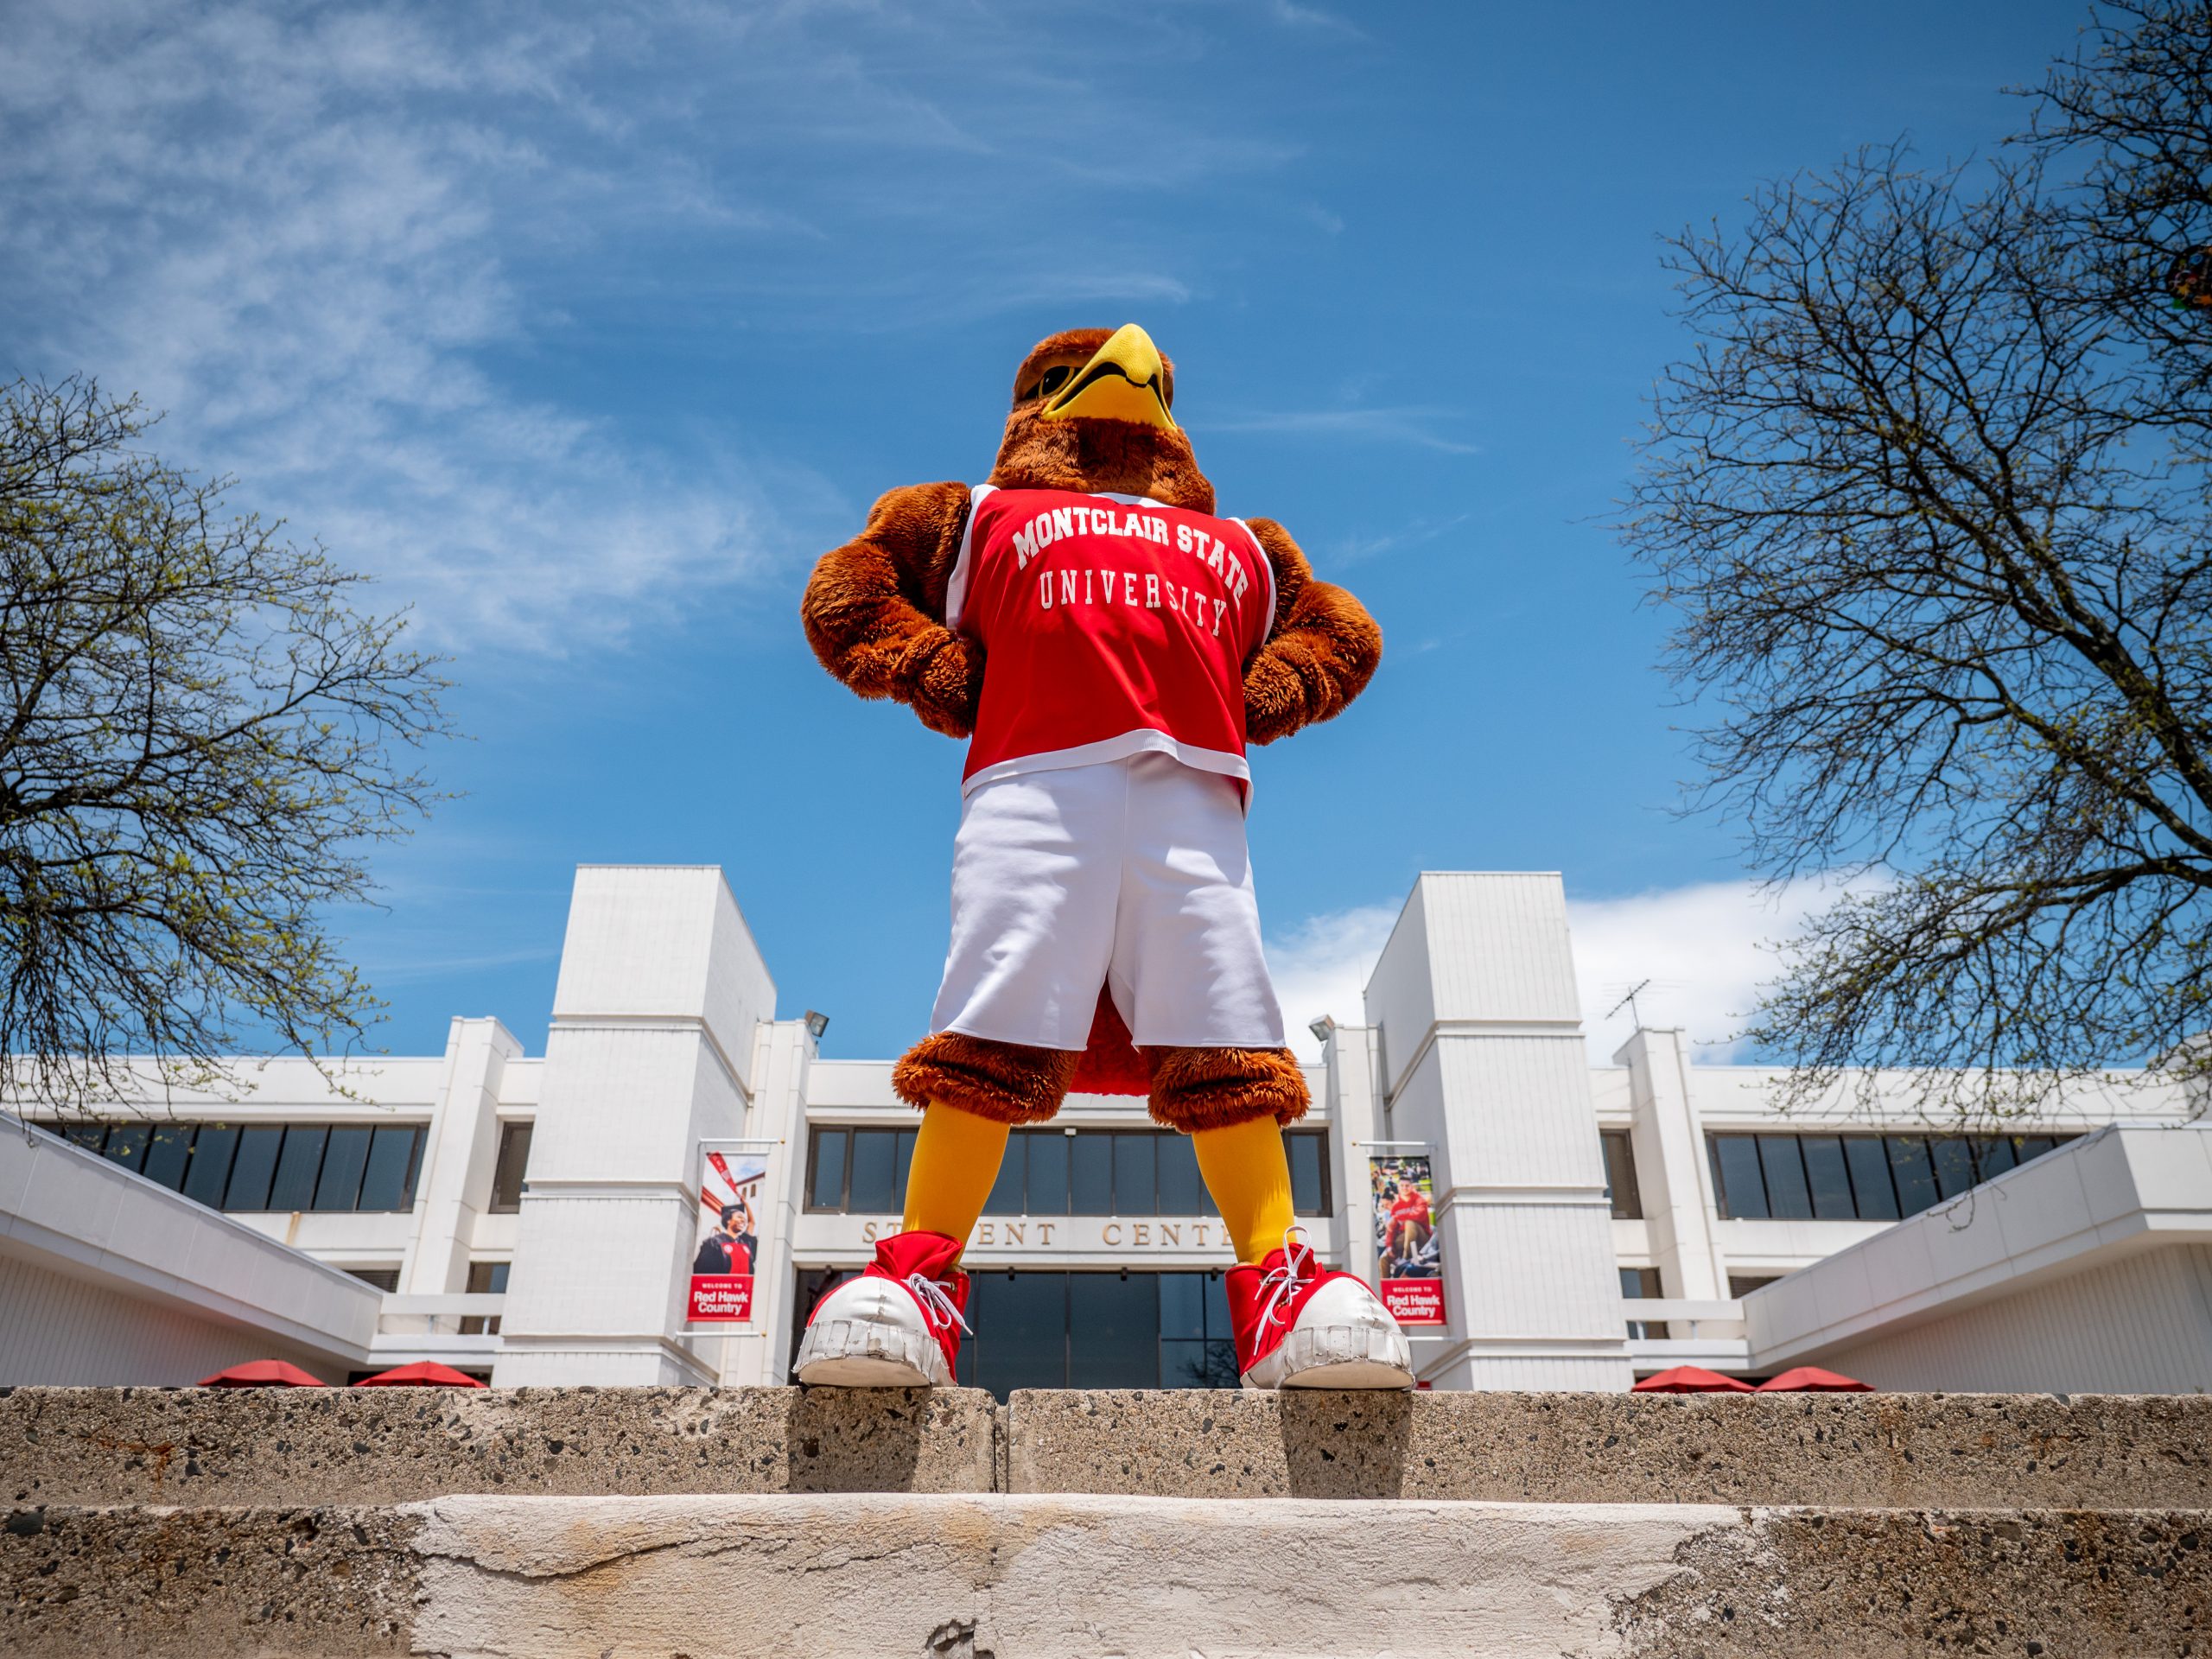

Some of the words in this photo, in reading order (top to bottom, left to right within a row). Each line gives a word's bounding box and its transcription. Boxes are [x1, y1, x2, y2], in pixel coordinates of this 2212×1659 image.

[1012, 506, 1169, 571] MONTCLAIR
[1177, 524, 1249, 611] STATE
[1039, 569, 1228, 637] UNIVERSITY
[862, 1222, 1056, 1246] STENT
[694, 1291, 716, 1302] Red
[718, 1291, 748, 1303] Hawk
[1387, 1294, 1409, 1306] Red
[1410, 1294, 1440, 1306] Hawk
[698, 1302, 742, 1316] Country
[1393, 1306, 1436, 1319] Country
